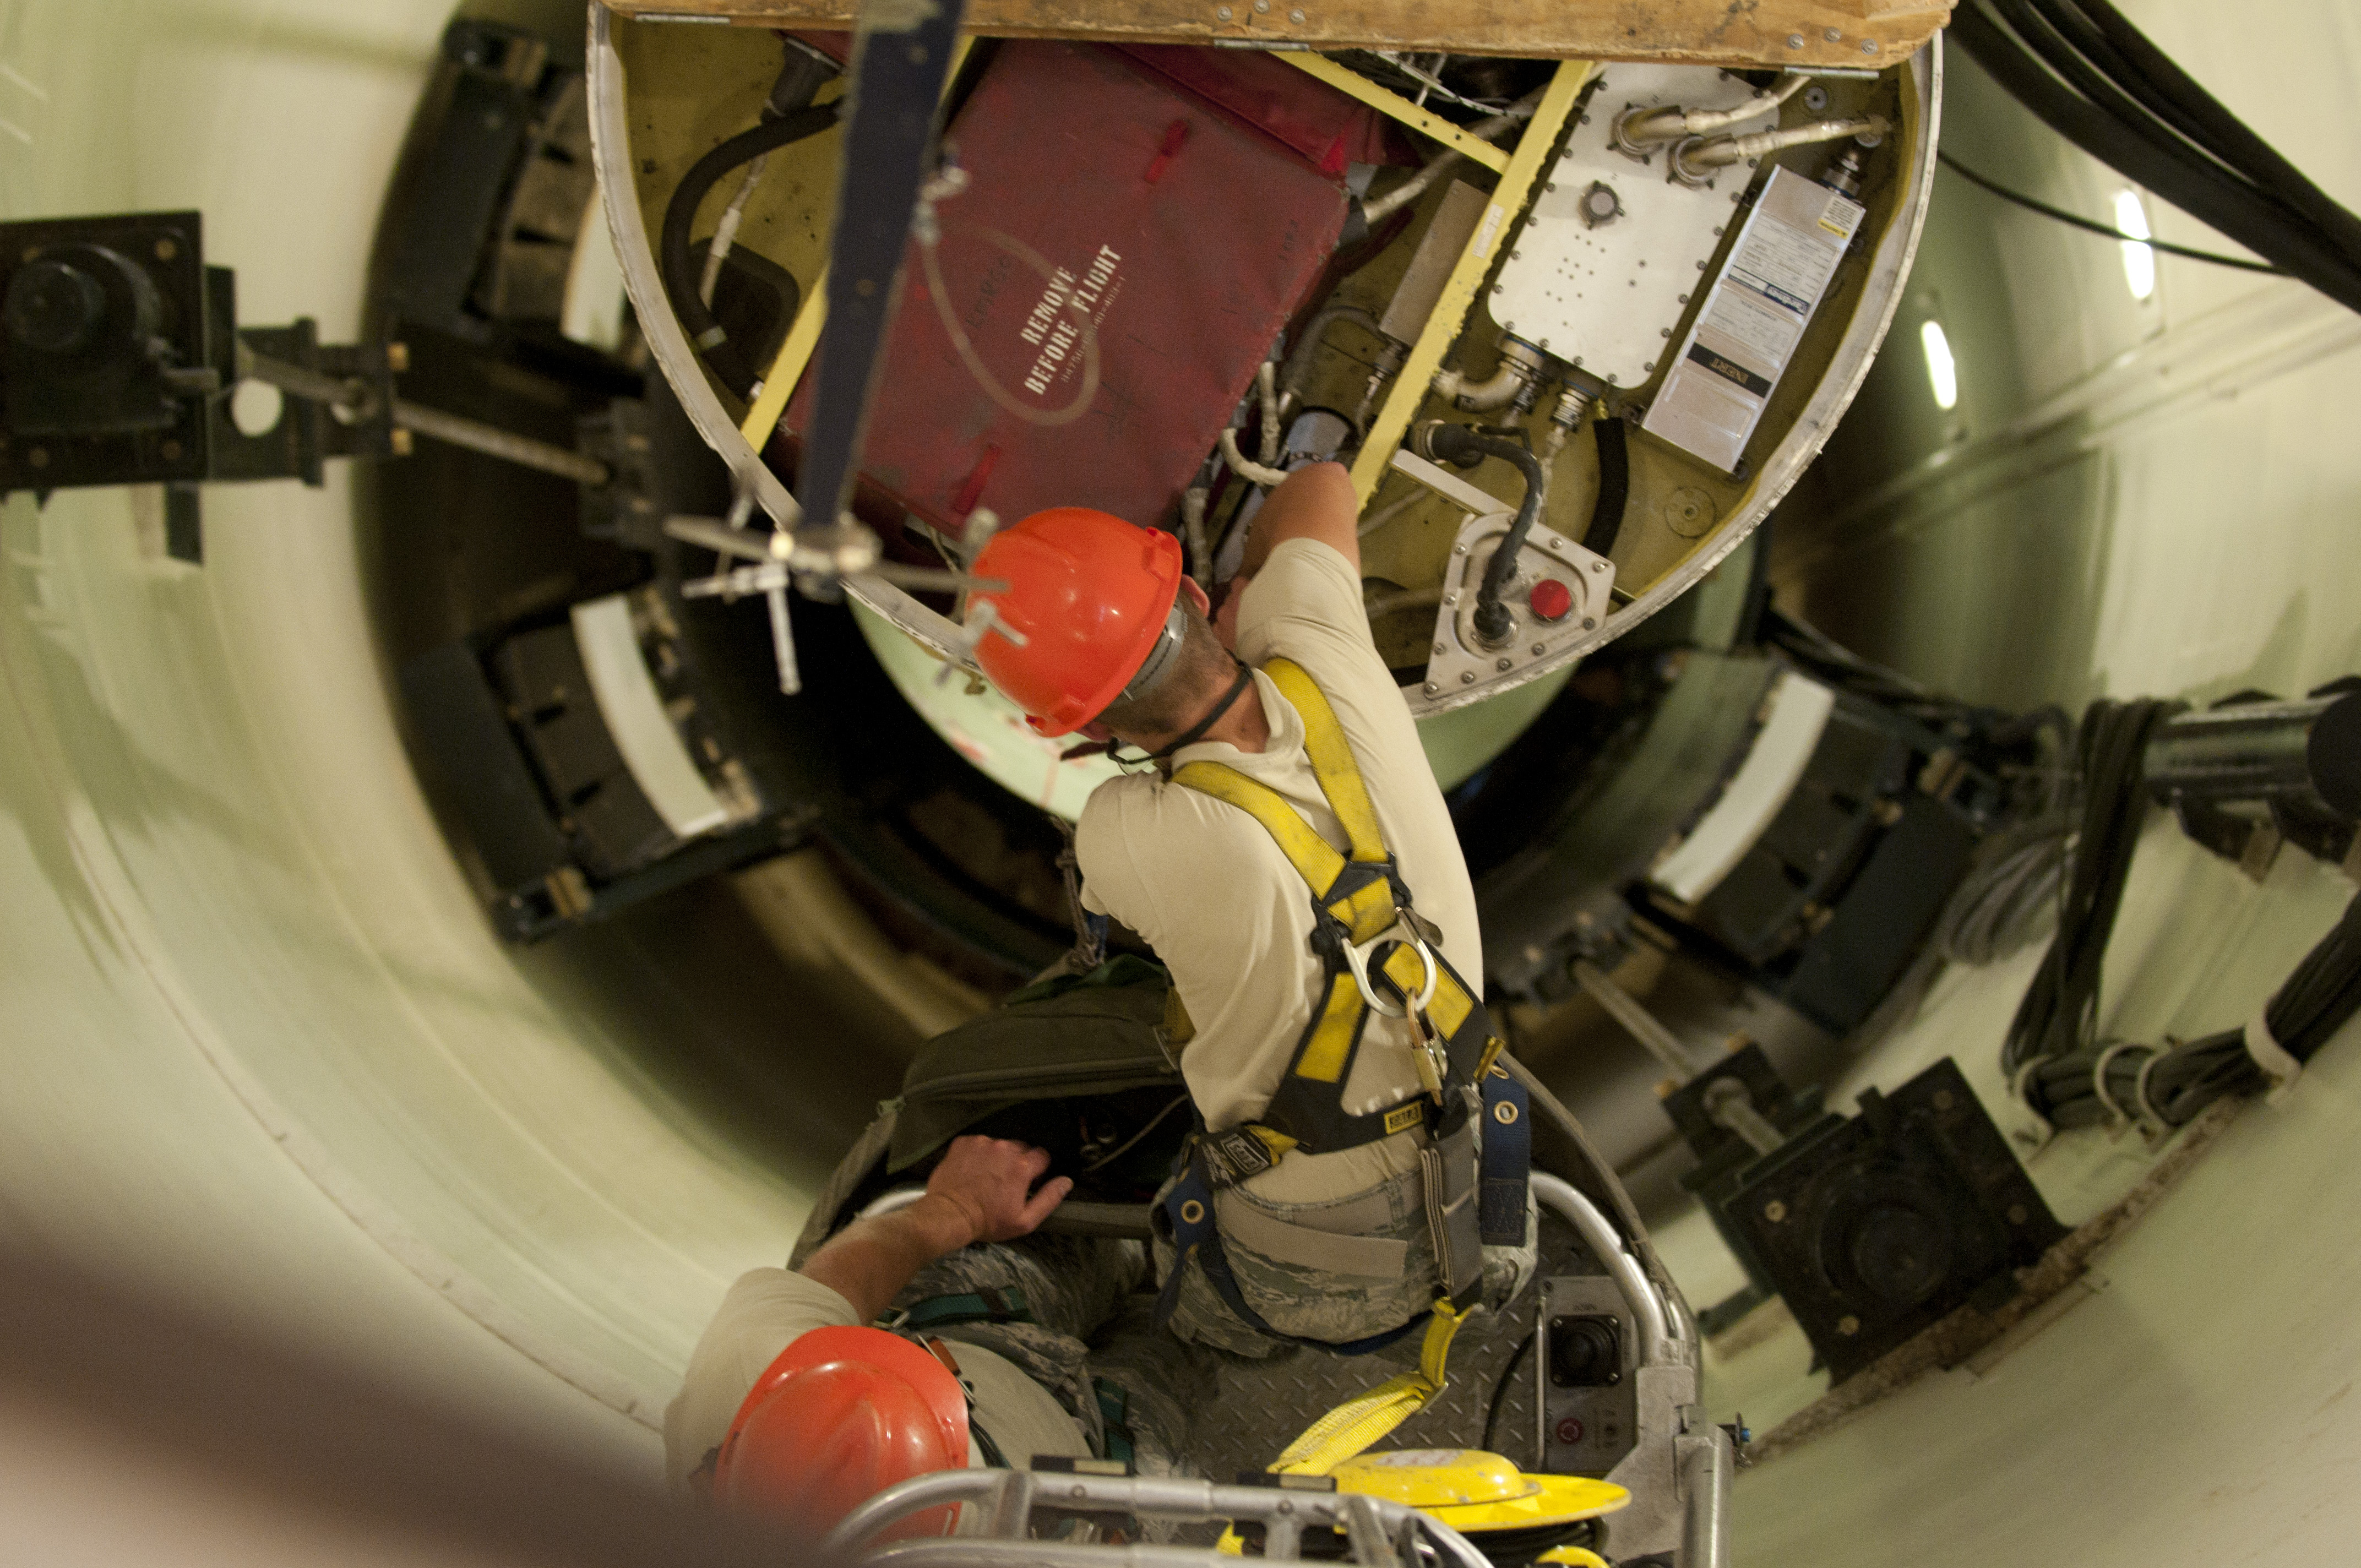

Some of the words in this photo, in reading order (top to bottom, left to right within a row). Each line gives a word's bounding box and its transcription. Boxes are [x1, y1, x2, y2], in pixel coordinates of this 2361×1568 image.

[1020, 266, 1078, 346] REMOVE
[1024, 319, 1079, 395] BEFORE
[1071, 244, 1122, 313] FLIGHT
[1709, 357, 1749, 384] INERT
